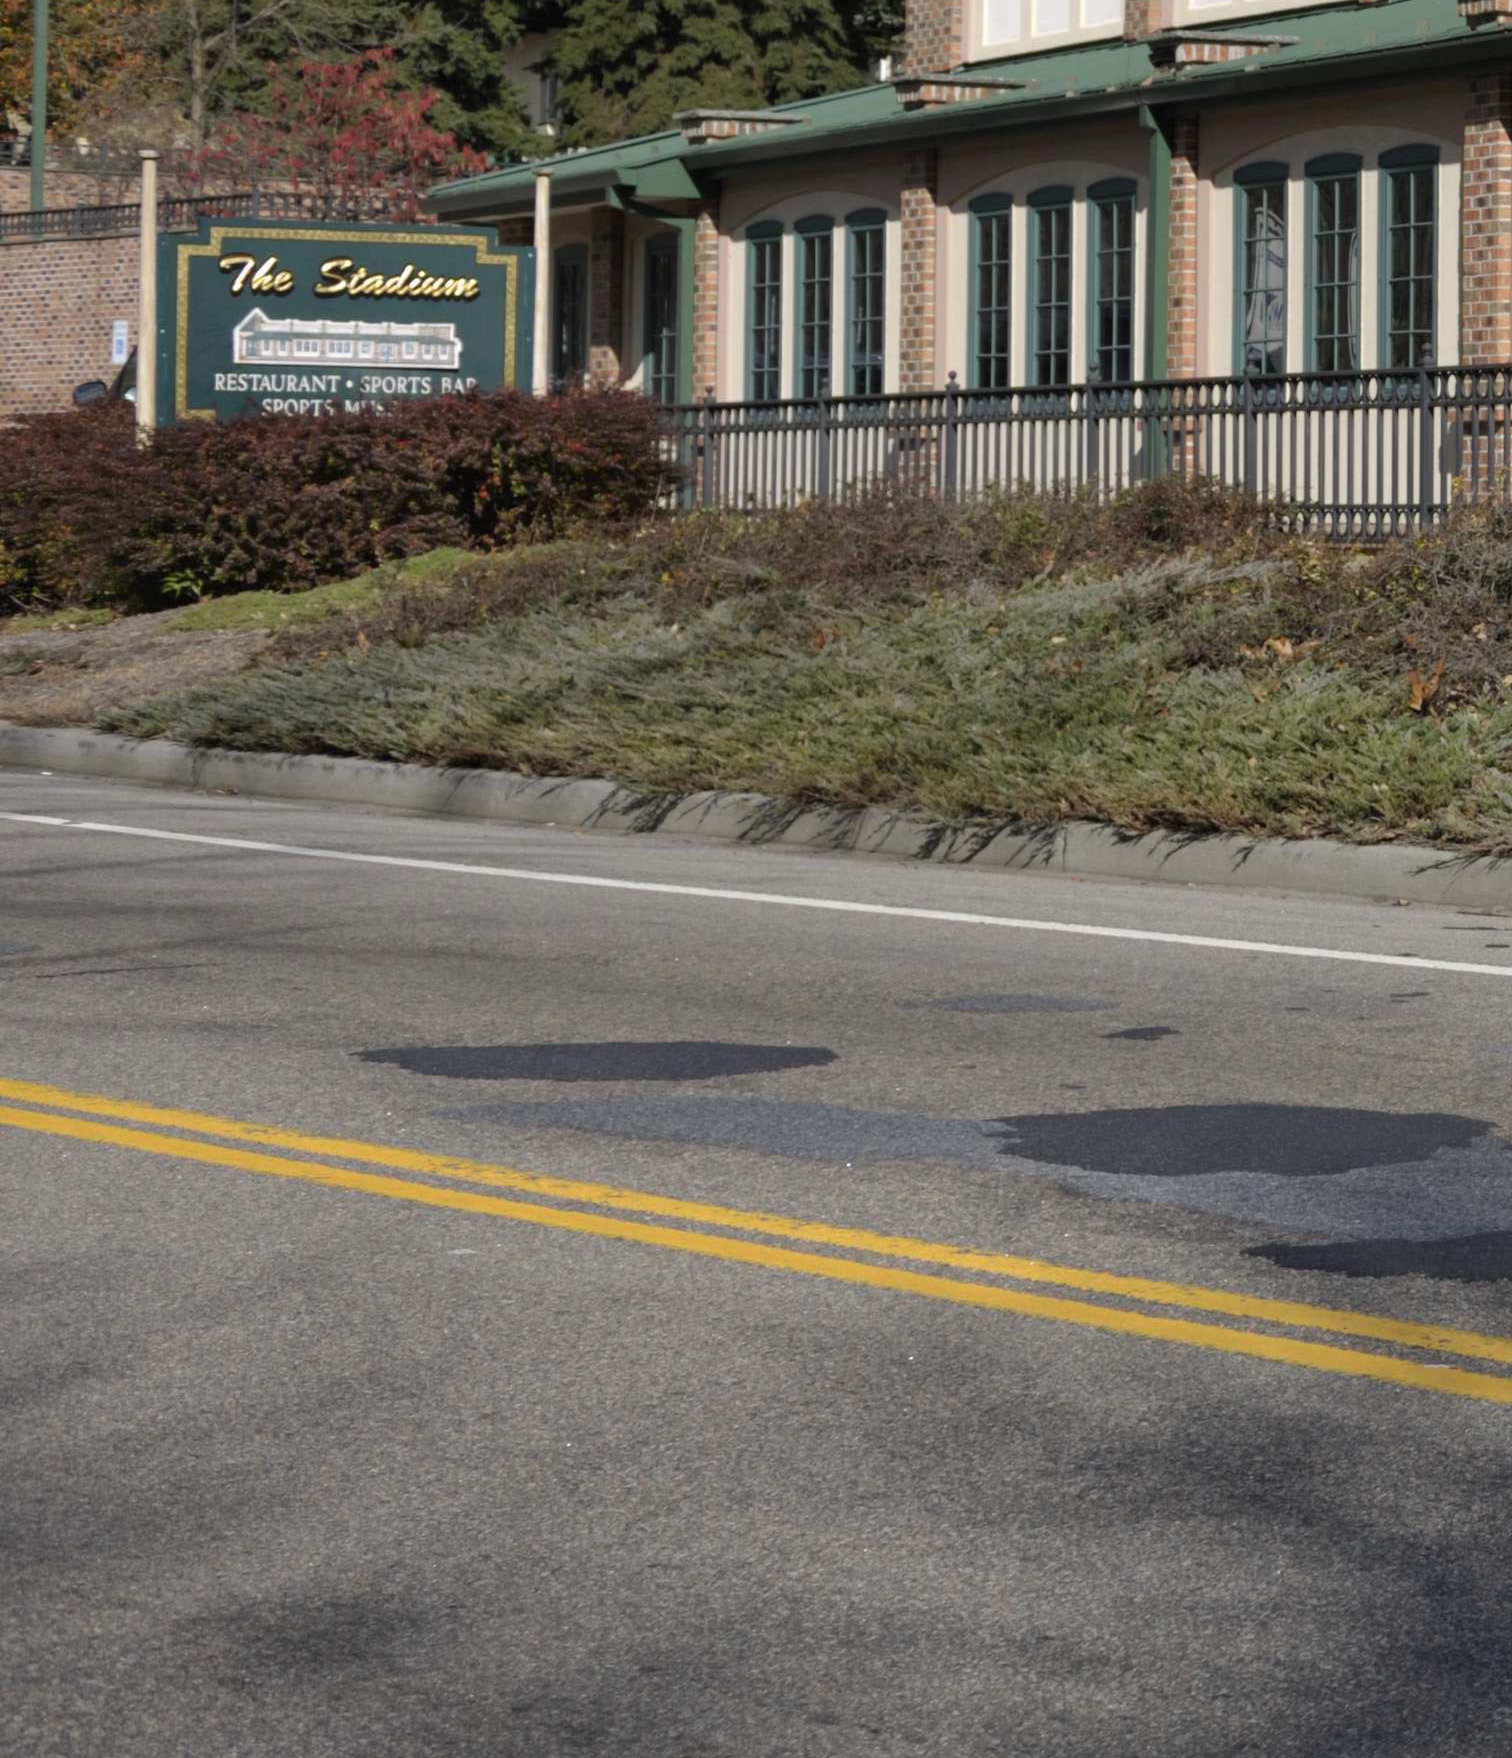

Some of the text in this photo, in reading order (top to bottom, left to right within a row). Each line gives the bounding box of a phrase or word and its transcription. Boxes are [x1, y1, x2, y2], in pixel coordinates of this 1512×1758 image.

[219, 254, 480, 298] The Stadium
[214, 373, 341, 394] RESTAURANT
[360, 375, 431, 395] SPORTS
